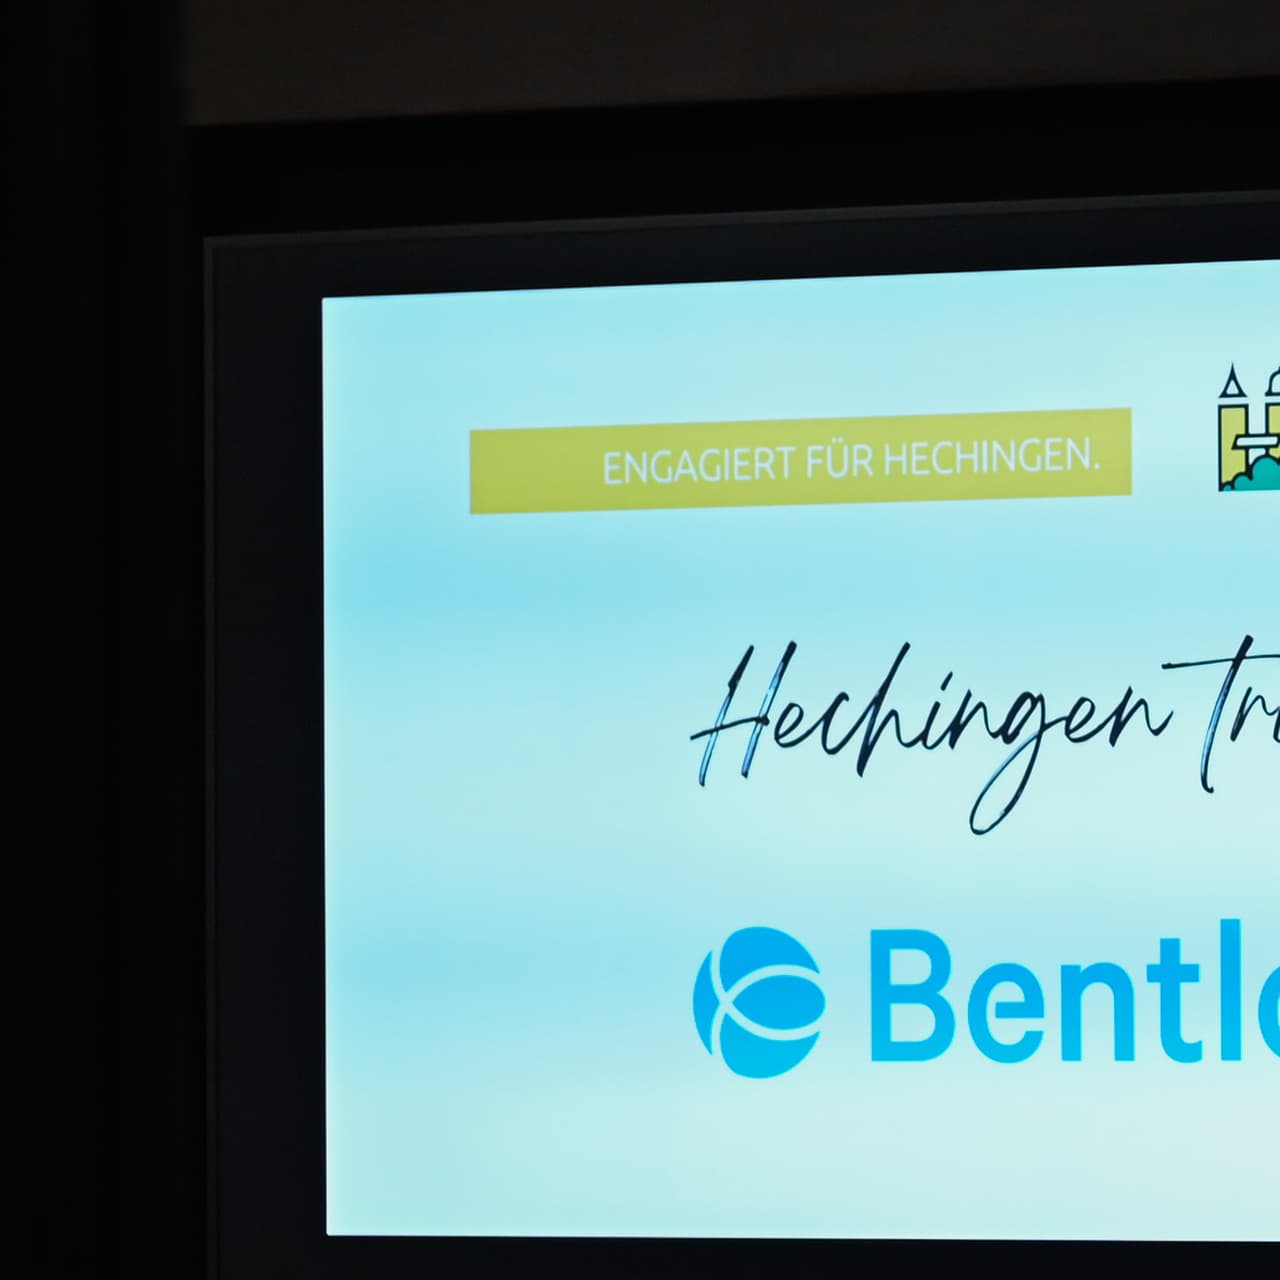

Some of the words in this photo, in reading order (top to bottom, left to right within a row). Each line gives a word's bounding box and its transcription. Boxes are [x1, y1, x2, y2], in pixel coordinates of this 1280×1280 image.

[603, 446, 797, 485] ENGAGIERT
[806, 437, 875, 479] FÜR
[884, 437, 1101, 476] HECHINGEN.
[690, 640, 1174, 836] Hechingen
